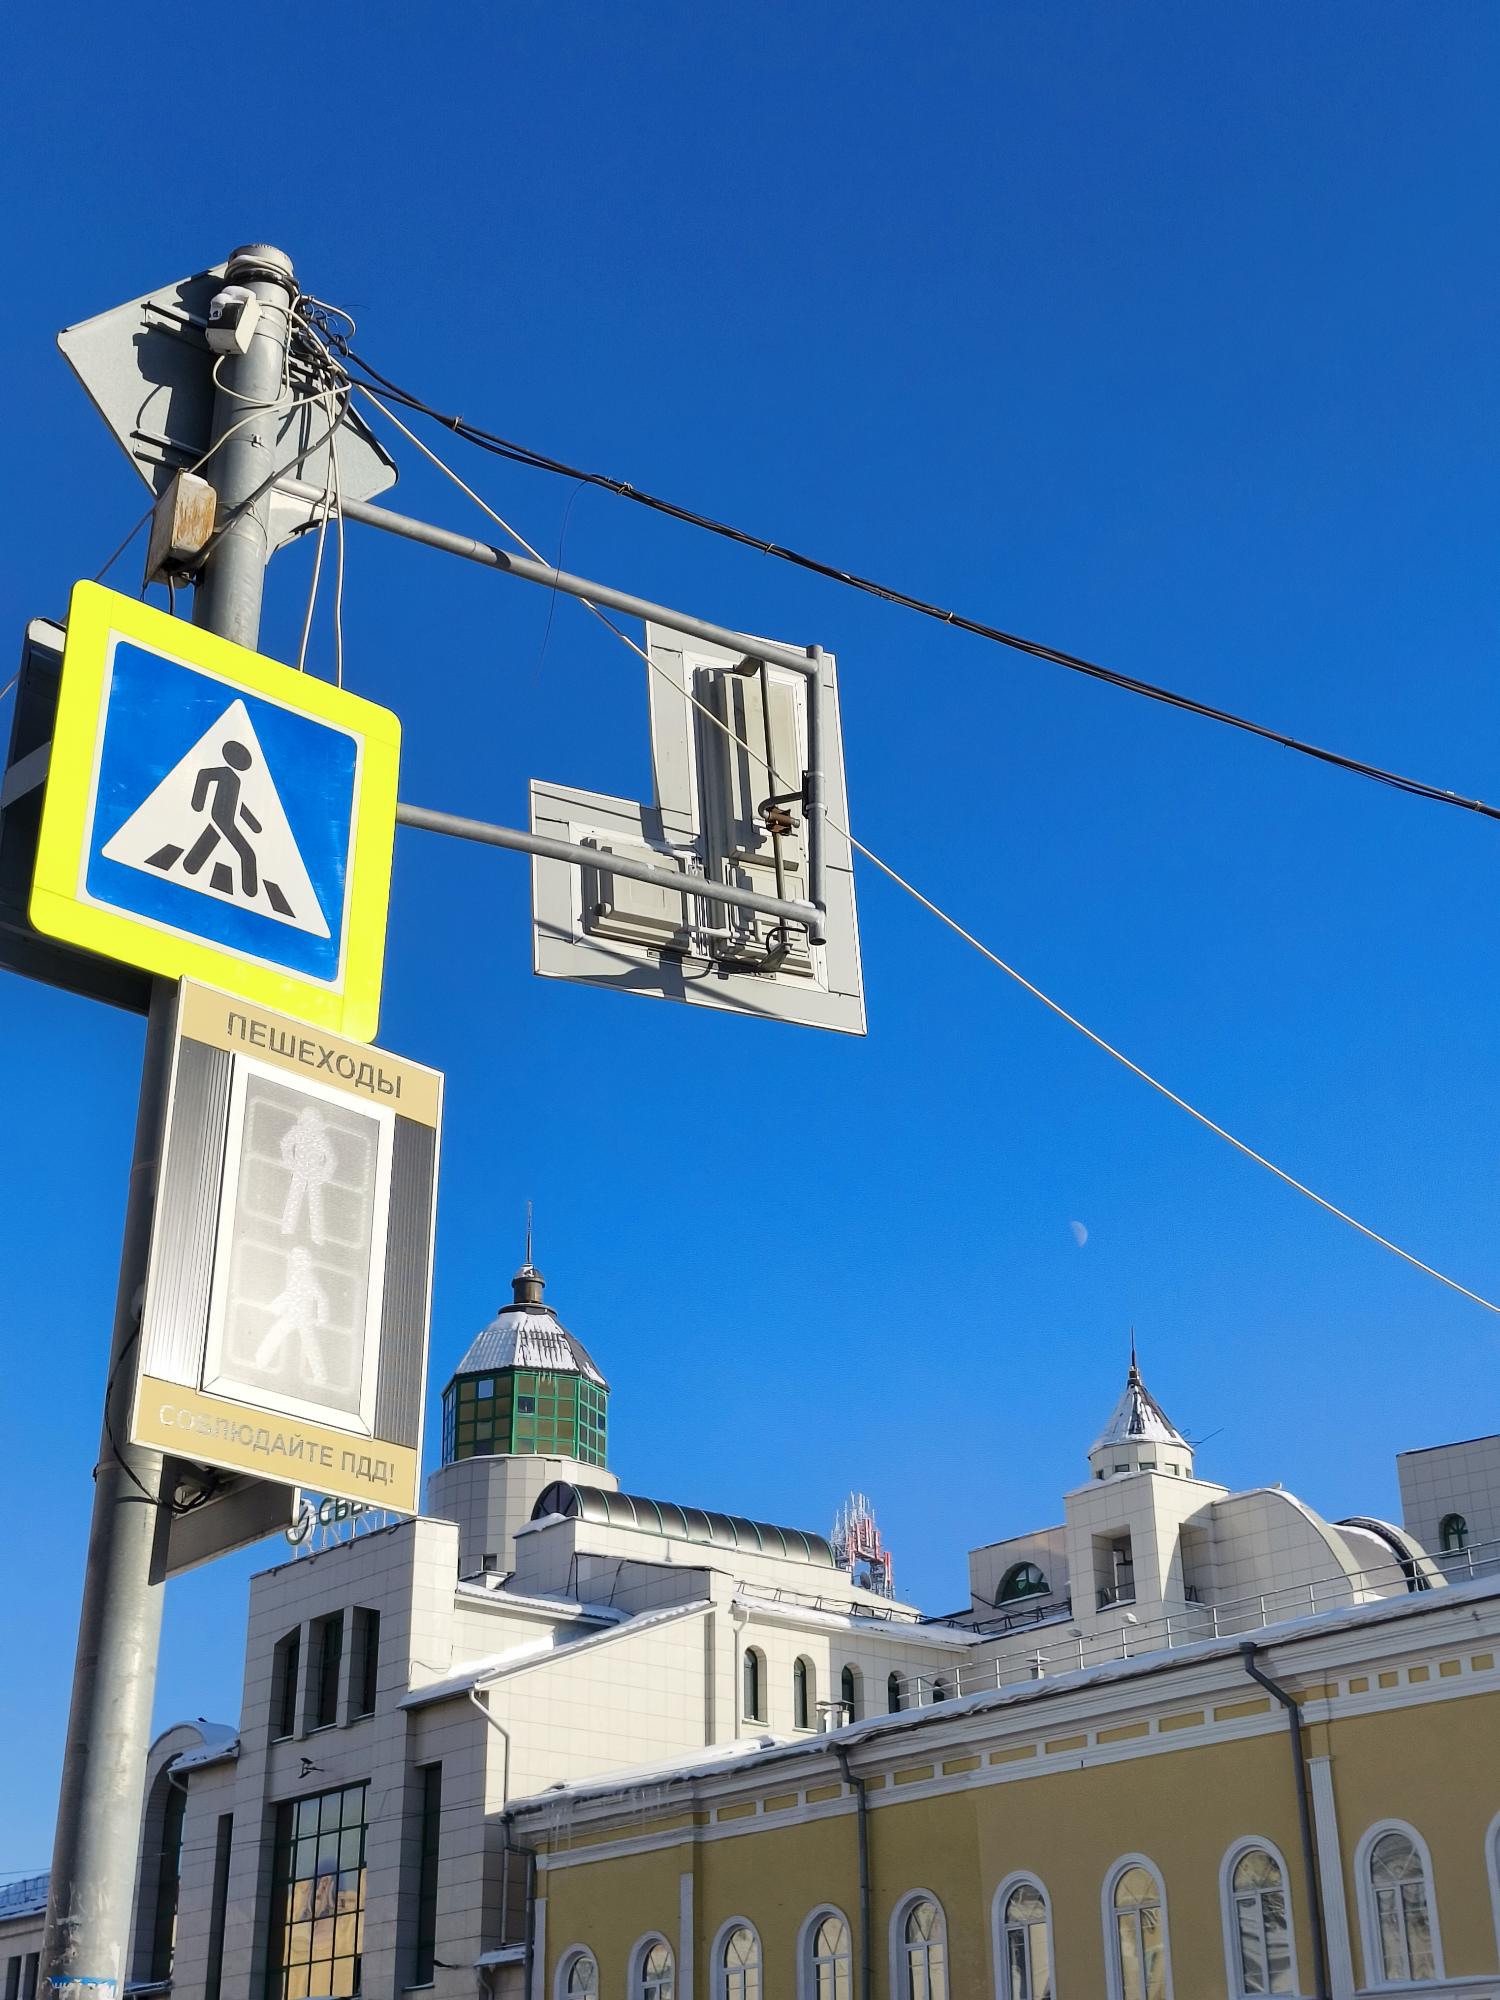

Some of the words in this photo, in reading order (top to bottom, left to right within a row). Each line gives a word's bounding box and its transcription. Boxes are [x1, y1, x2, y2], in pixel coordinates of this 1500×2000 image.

[228, 1012, 401, 1098] ПЕШЕХОДЫ
[159, 1404, 334, 1468] СОБЛЮДАЙТЕ
[341, 1452, 395, 1486] ПДД!
